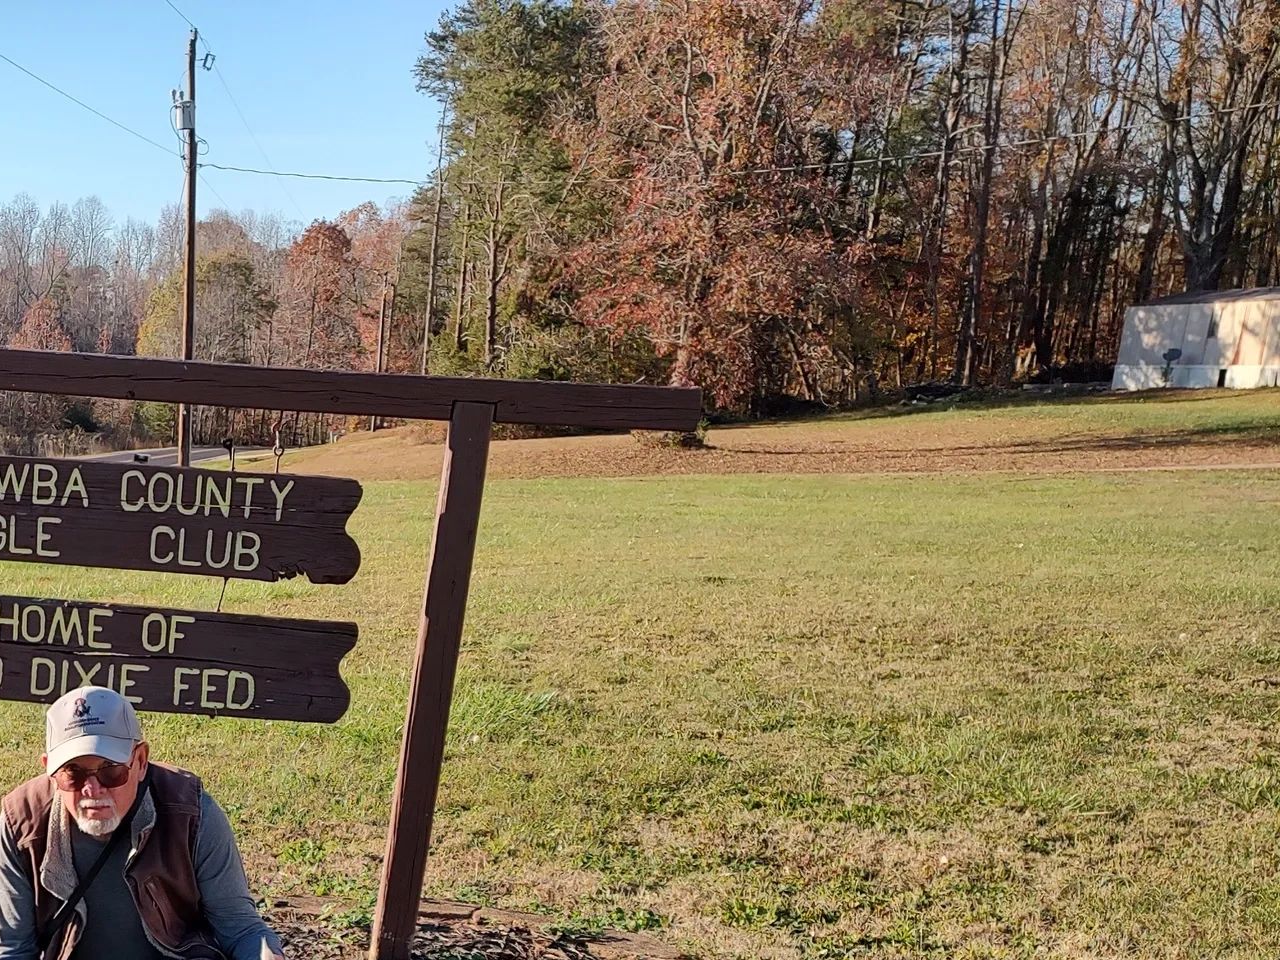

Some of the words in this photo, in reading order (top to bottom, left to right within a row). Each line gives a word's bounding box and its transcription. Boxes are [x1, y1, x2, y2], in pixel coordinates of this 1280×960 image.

[120, 469, 295, 522] COUNTY
[149, 525, 261, 571] CLUB
[141, 612, 196, 655] OF
[30, 657, 150, 703] DIXIE
[172, 667, 255, 710] FED
